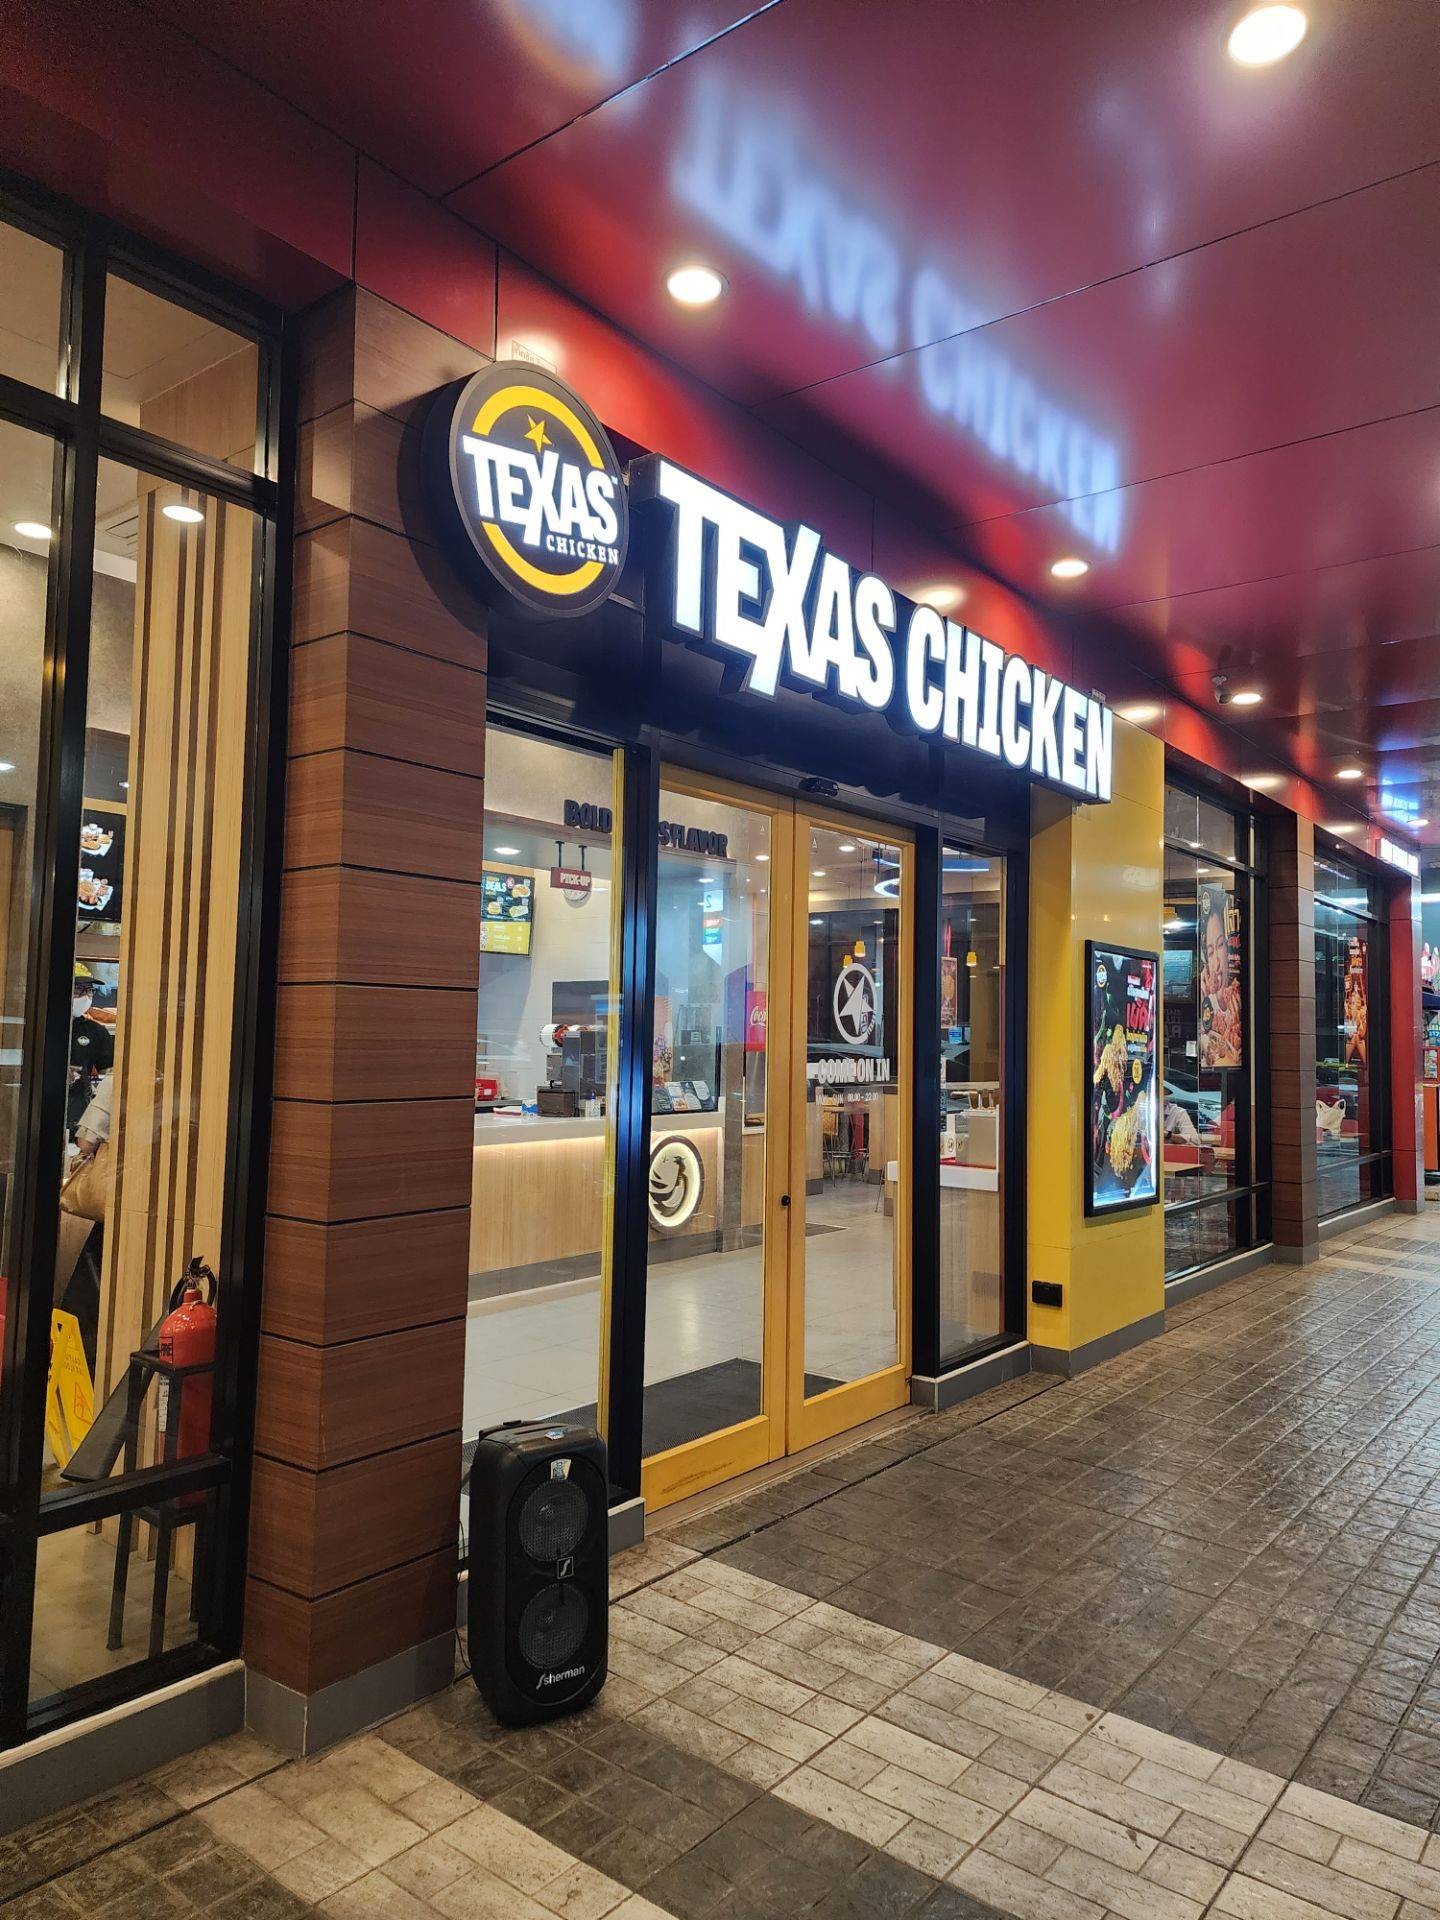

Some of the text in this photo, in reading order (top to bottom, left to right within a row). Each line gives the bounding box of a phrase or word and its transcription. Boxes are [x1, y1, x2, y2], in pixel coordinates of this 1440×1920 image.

[462, 435, 619, 547] TEXAS
[546, 534, 619, 565] CHICKEN
[658, 460, 1113, 803] TEXAS CHICKEN
[564, 799, 613, 834] BOLD
[560, 872, 591, 887] PICK-UP
[818, 1057, 890, 1084] COME ON IN
[543, 1665, 585, 1686] sherman
